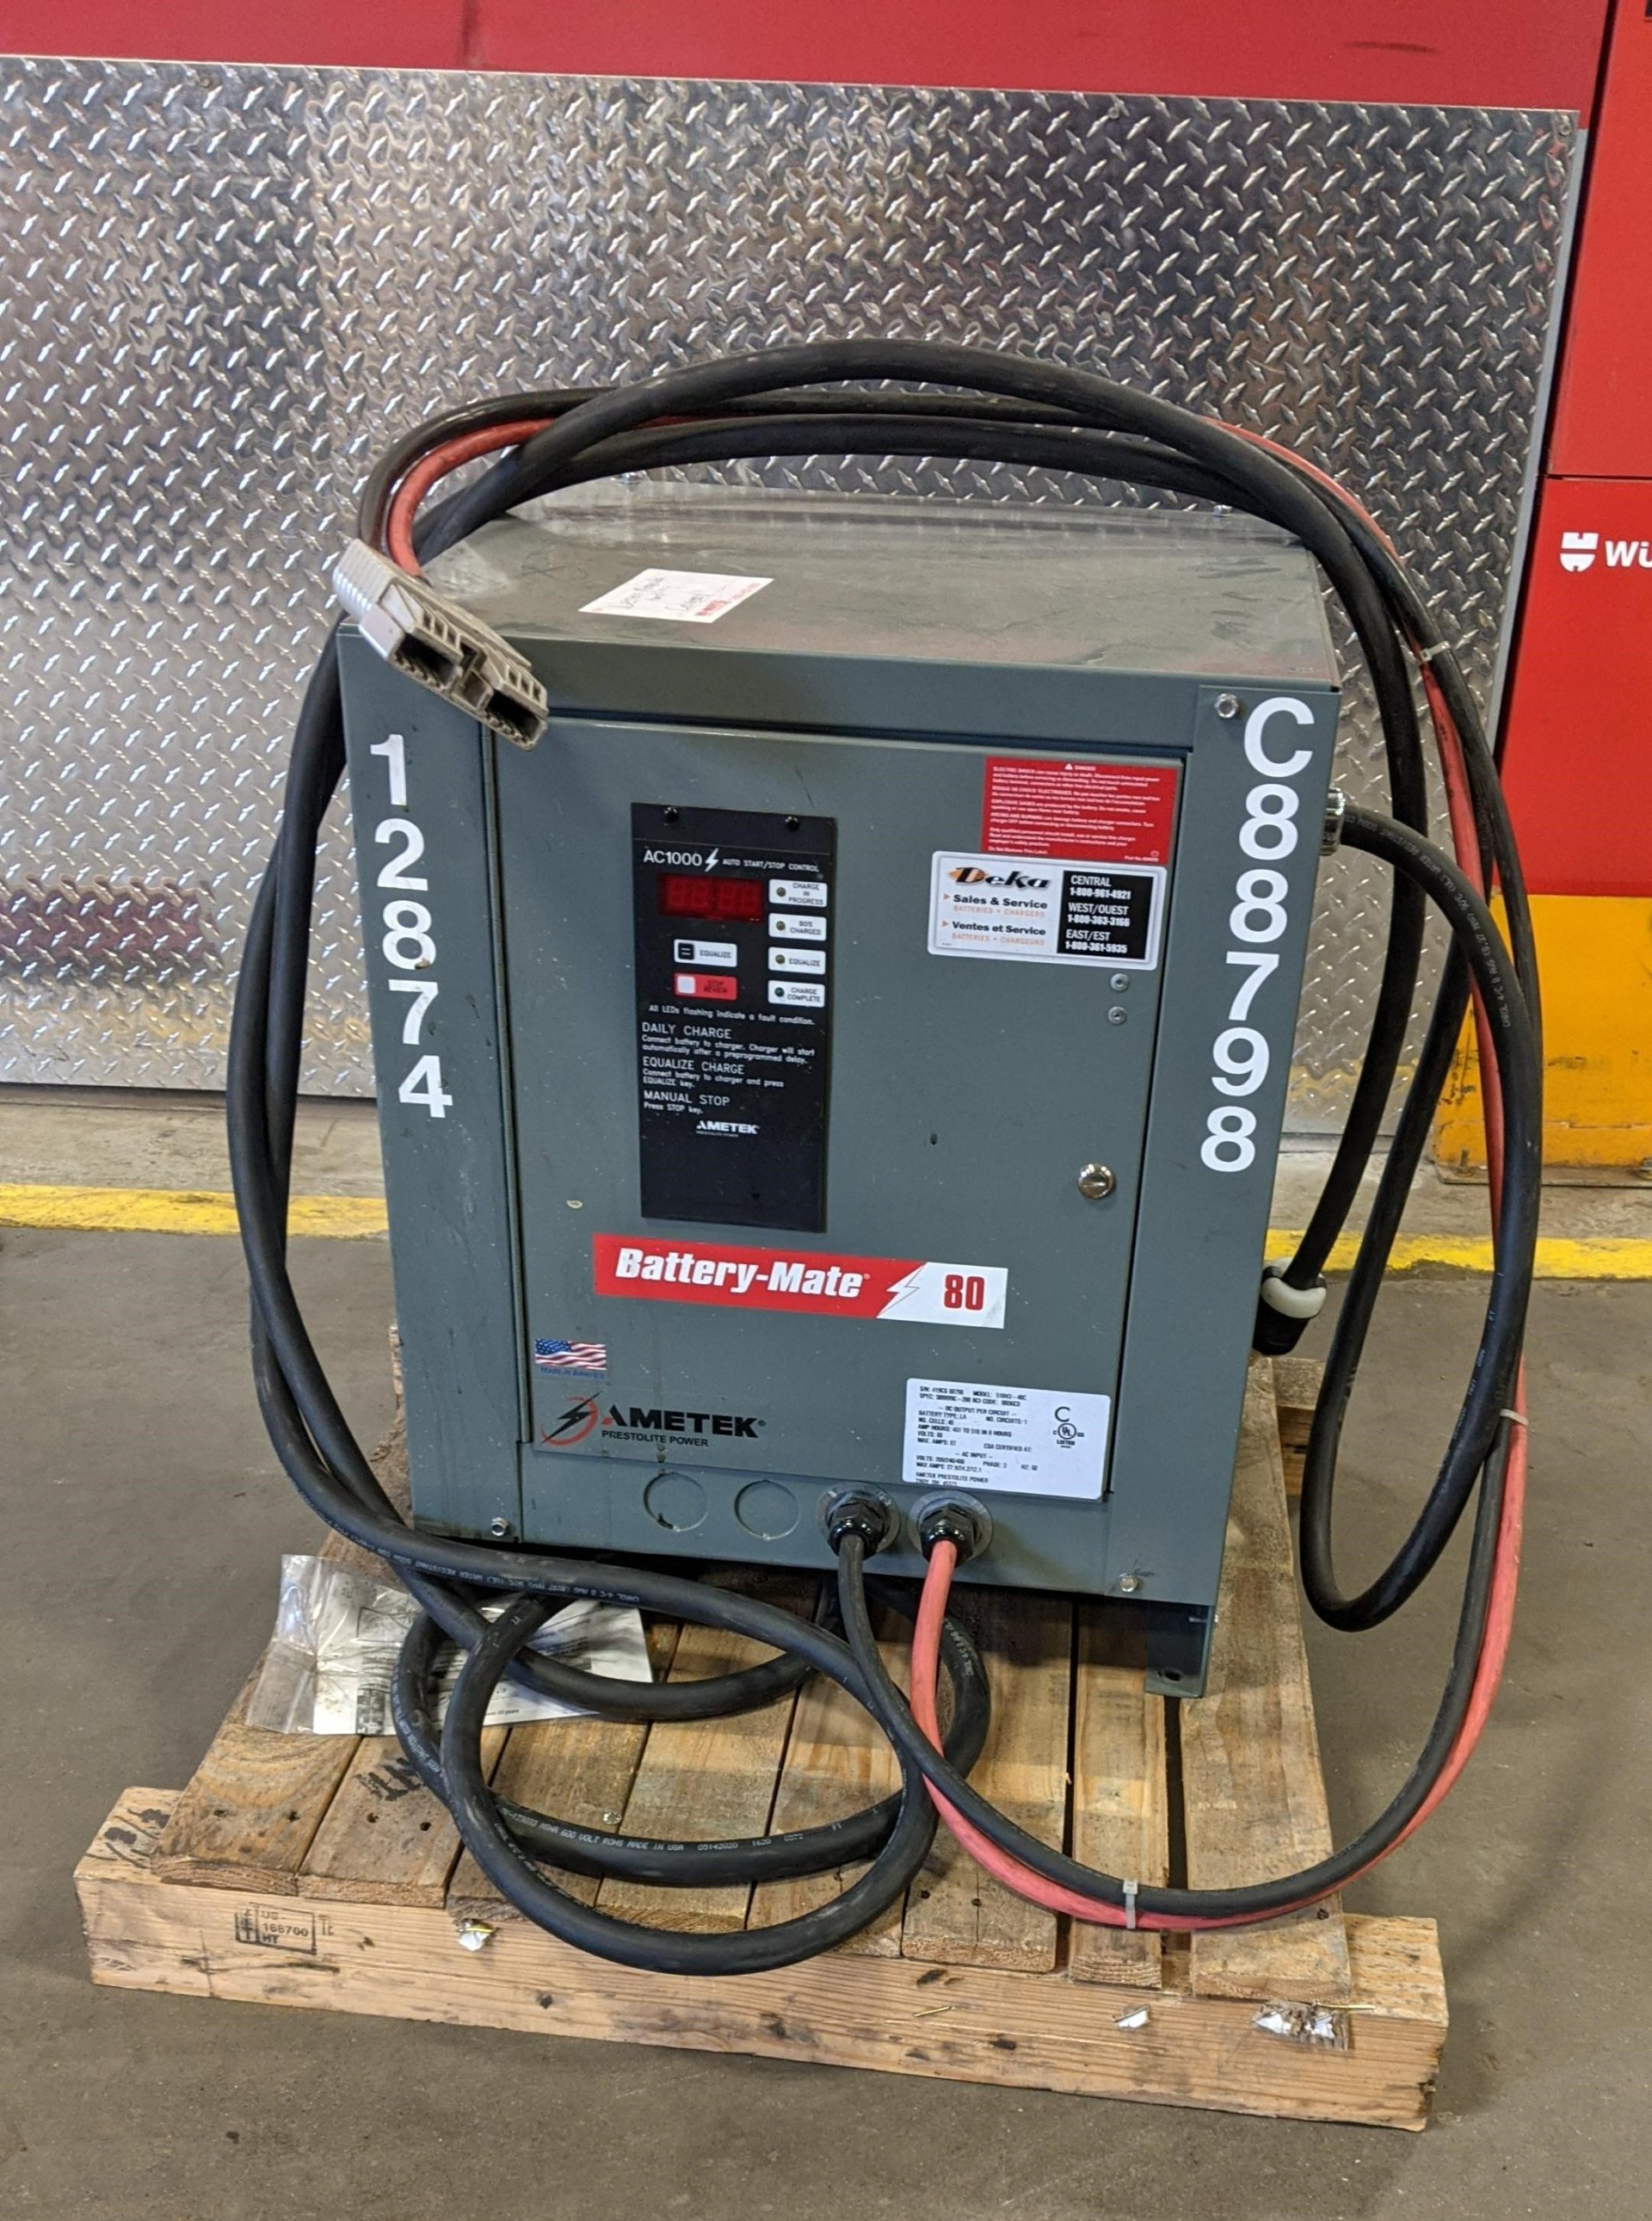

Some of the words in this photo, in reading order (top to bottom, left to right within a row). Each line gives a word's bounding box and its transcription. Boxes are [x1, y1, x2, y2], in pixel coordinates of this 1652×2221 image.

[644, 849, 702, 866] AC1000
[949, 867, 1050, 890] Deka
[1071, 874, 1112, 887] CENTRAL
[952, 894, 987, 904] Sales
[989, 897, 999, 905] &
[1002, 898, 1047, 909] Service
[1069, 902, 1129, 916] WEST/OUEST
[370, 733, 453, 1118] 12874
[952, 921, 989, 932] Ventes
[992, 924, 1003, 933] et
[1006, 925, 1045, 935] Service
[1200, 696, 1315, 1172] C88798
[1066, 929, 1111, 941] EAST/EST
[642, 1022, 676, 1033] DAILY
[683, 1026, 732, 1040] CHARGE
[643, 1057, 694, 1070] EQUALIZE
[702, 1062, 744, 1074] CHARGE
[644, 1090, 693, 1104] MANUAL
[700, 1095, 730, 1106] STOP
[696, 1120, 758, 1134] AMETEK
[615, 1248, 863, 1299] Battery-Mate
[943, 1274, 986, 1311] 80
[602, 1404, 758, 1438] AMETEK
[601, 1430, 666, 1444] PRESTOLITE
[669, 1435, 709, 1447] POWER
